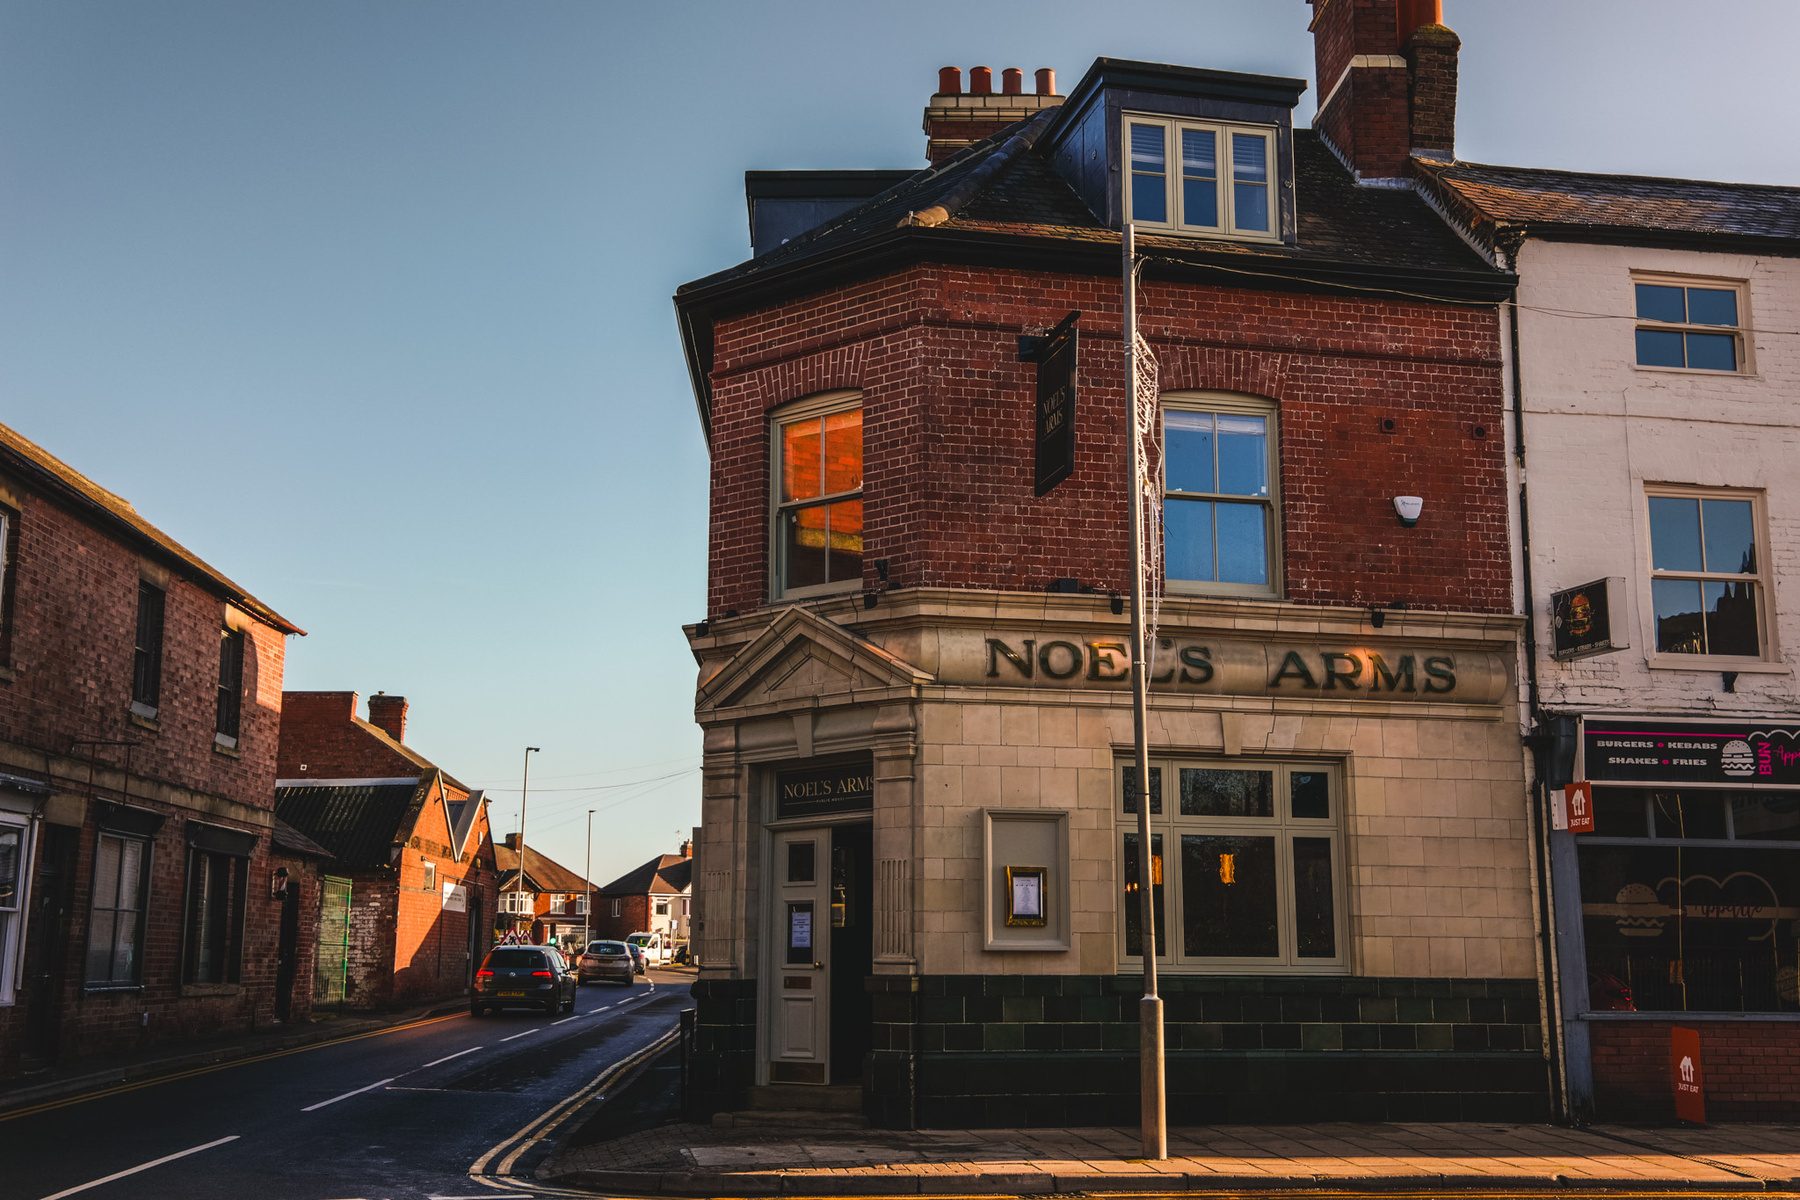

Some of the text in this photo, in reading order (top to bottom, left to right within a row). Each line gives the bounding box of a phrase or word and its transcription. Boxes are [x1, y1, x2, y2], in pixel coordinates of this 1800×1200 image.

[1043, 385, 1066, 419] NOEL'S
[1044, 407, 1064, 436] ARMS
[1269, 650, 1457, 692] ARMS
[1597, 740, 1718, 750] BURGERS KEBABS
[1608, 757, 1659, 765] SHAKES
[1758, 742, 1772, 775] BUN
[784, 780, 832, 799] NOEL'S
[1570, 817, 1590, 828] JUST EAT
[1678, 1082, 1699, 1093] JUST EAT
